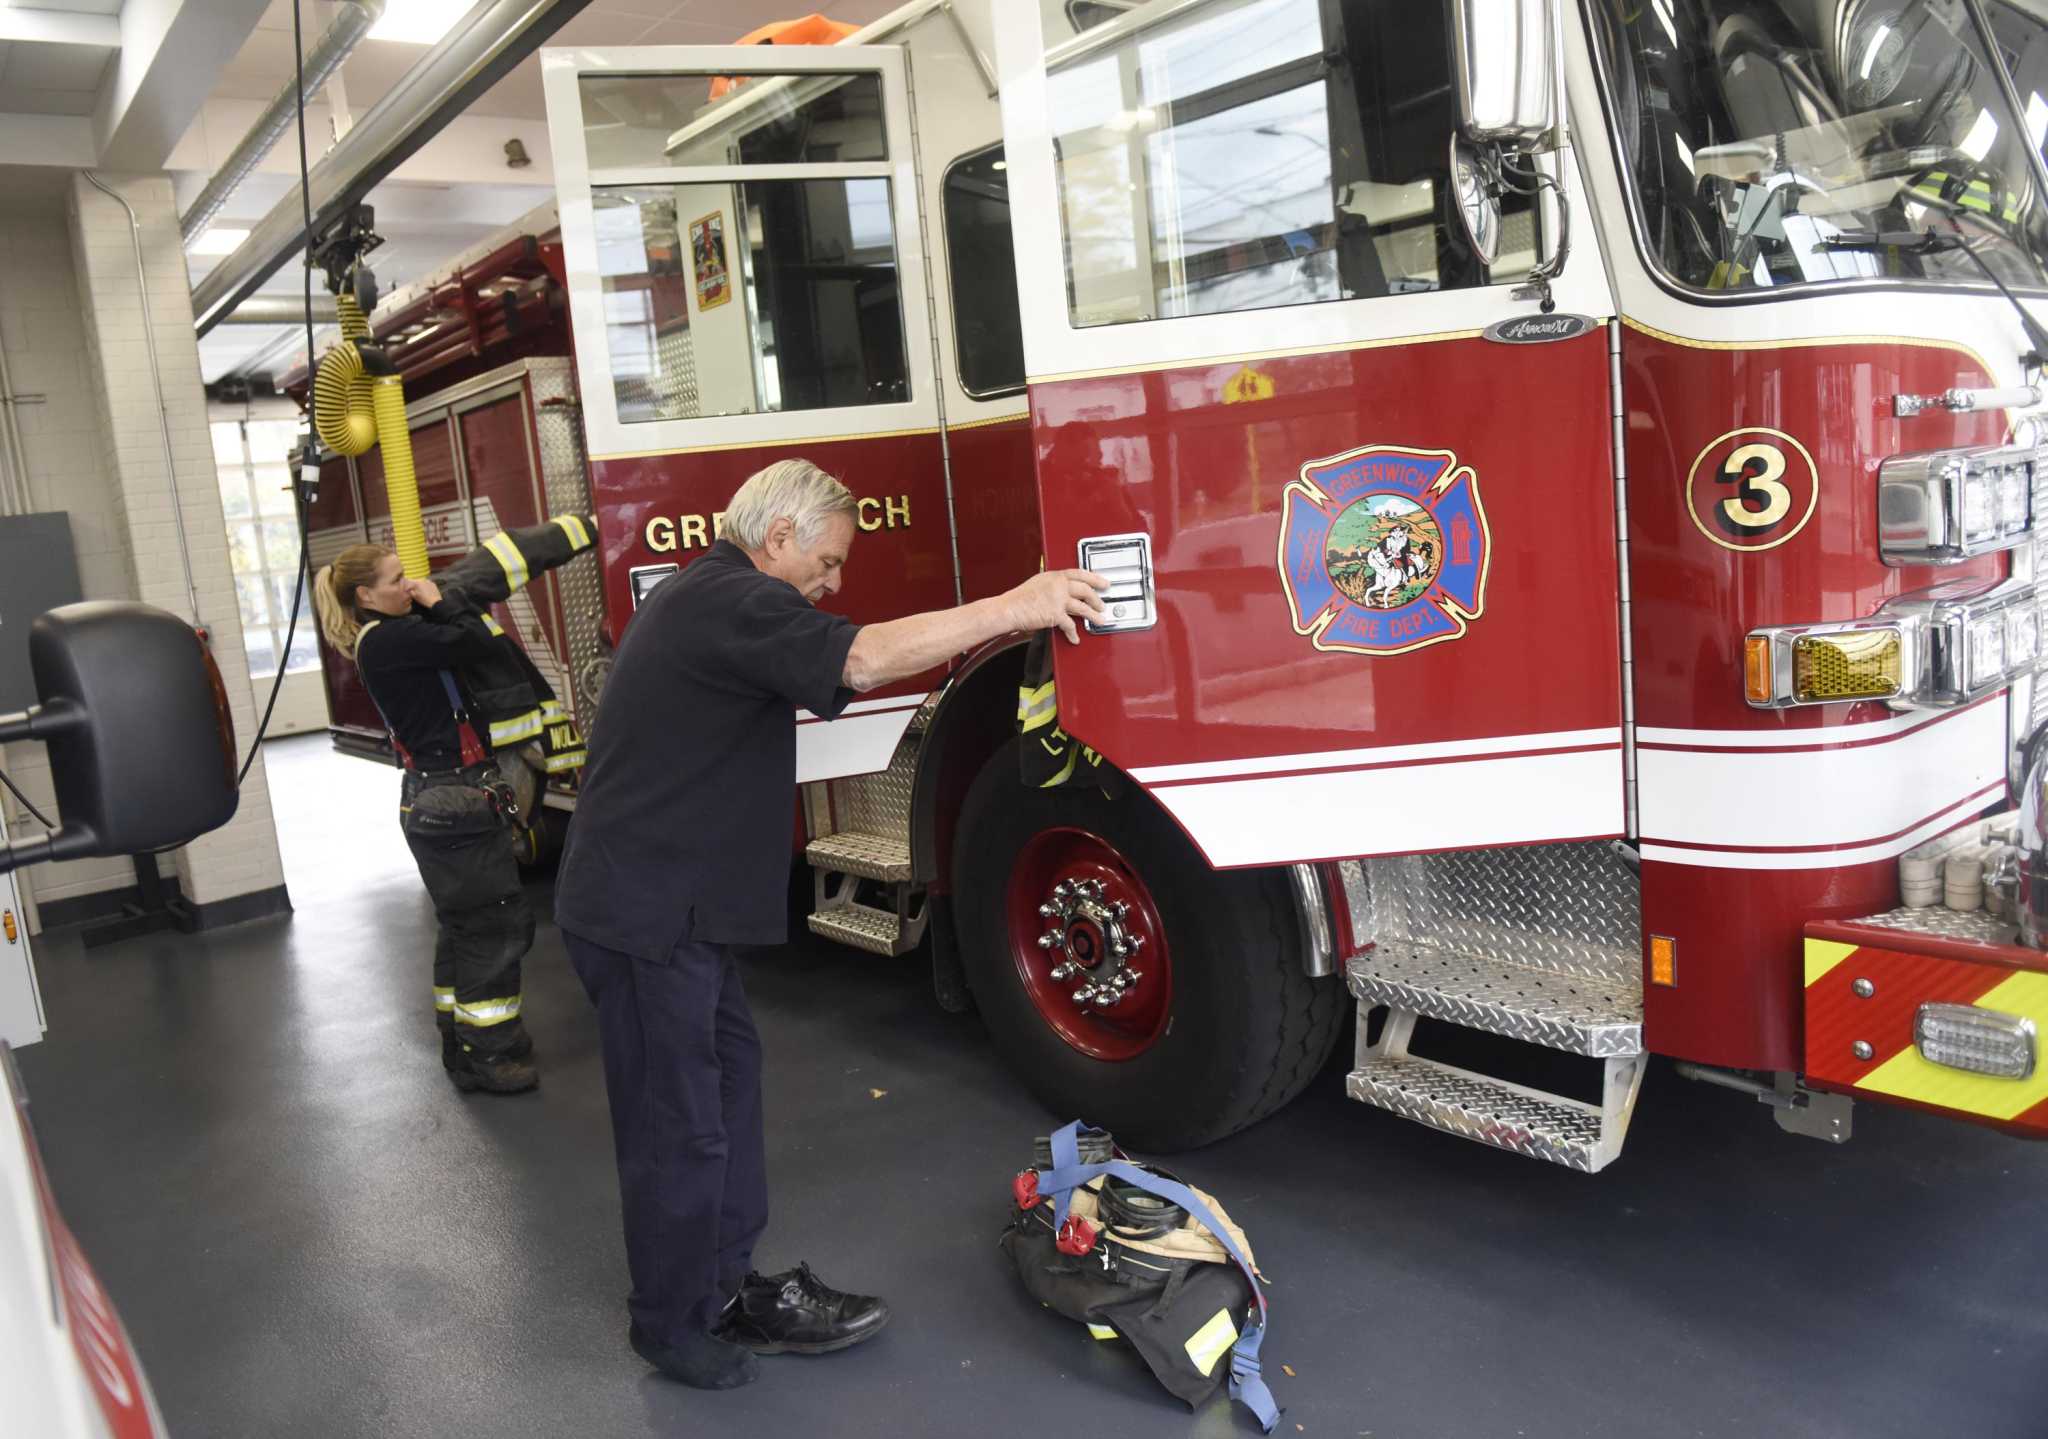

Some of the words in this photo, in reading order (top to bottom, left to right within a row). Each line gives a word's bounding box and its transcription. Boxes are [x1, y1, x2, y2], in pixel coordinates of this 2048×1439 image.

[1327, 462, 1428, 495] GREENWICH
[1720, 443, 1792, 530] 3
[1341, 613, 1380, 640] FIRE
